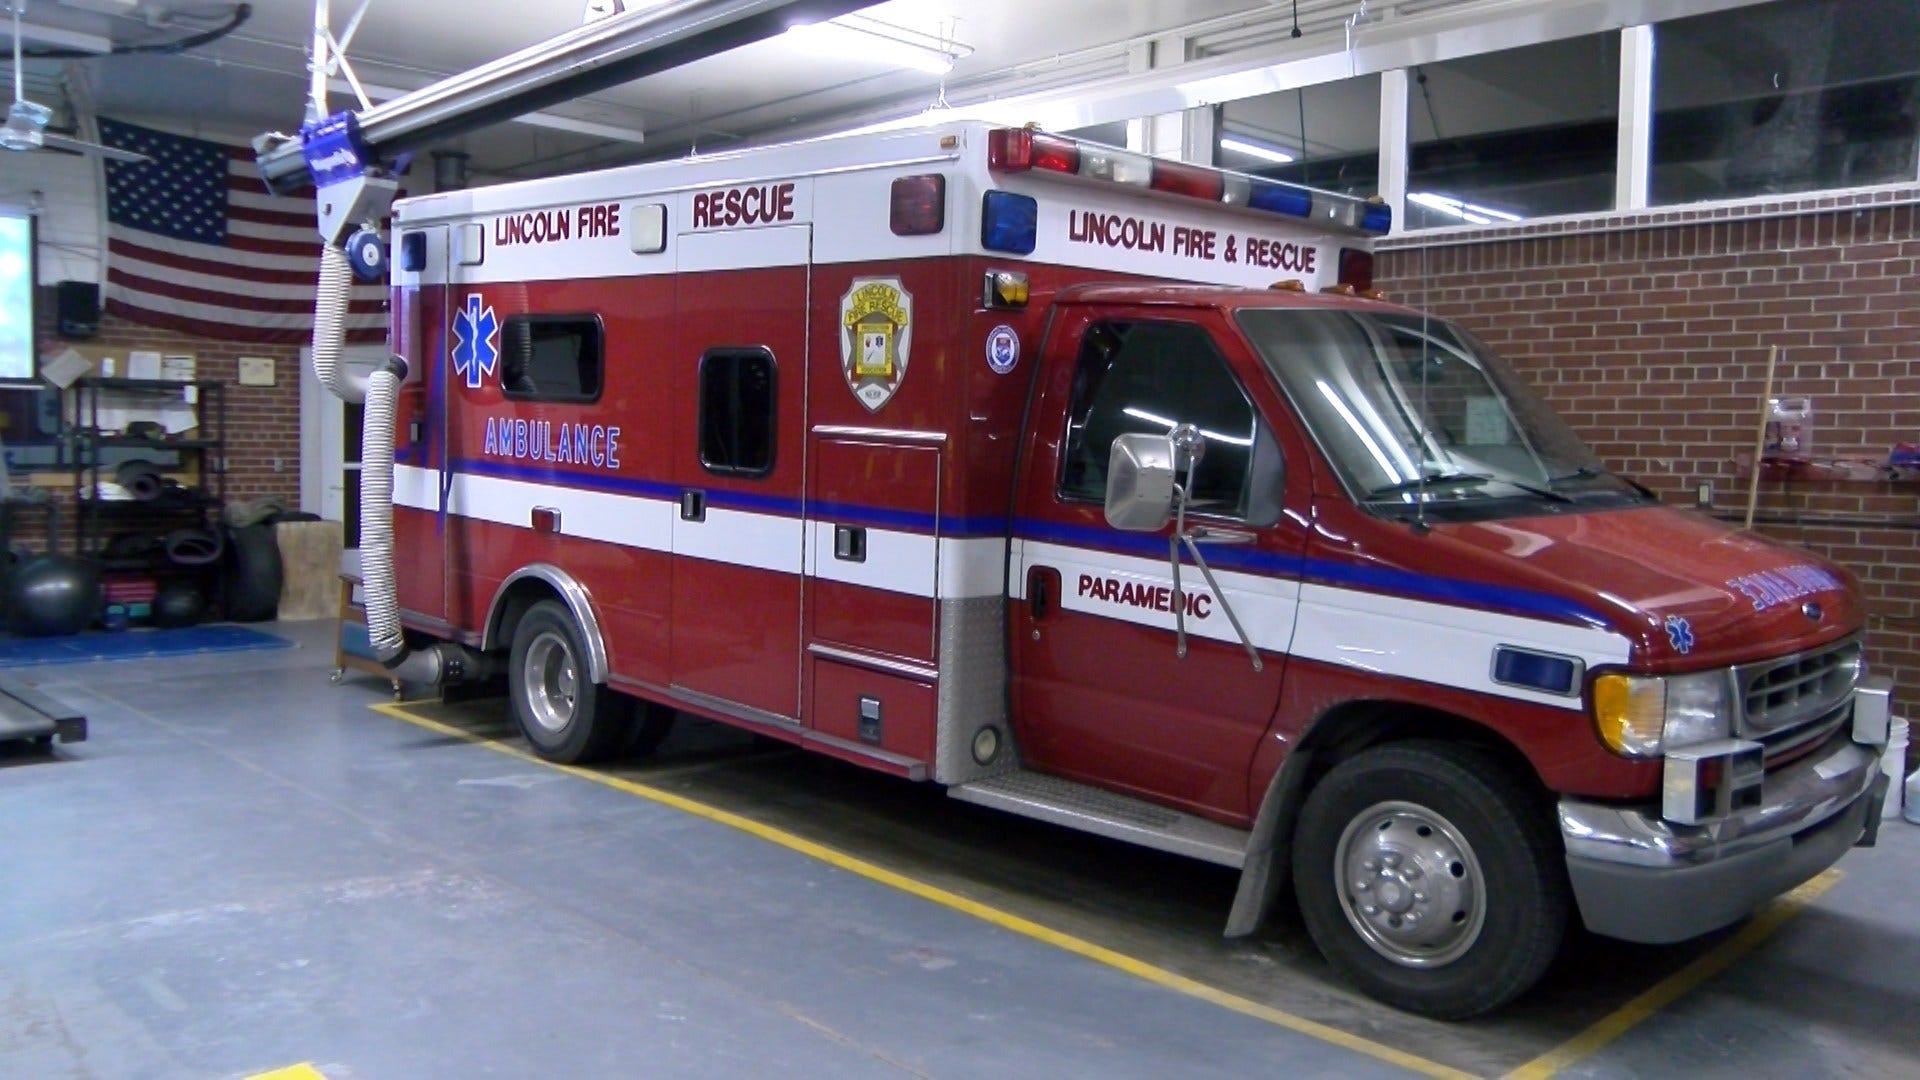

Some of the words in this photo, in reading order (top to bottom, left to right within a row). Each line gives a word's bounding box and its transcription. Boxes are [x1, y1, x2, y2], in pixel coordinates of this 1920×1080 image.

[495, 209, 570, 246] LINCOLN
[577, 203, 620, 237] FIRE
[693, 183, 795, 228] RESCUE
[1069, 210, 1166, 252] LINCOLN
[1173, 226, 1216, 260] FIRE
[1224, 234, 1238, 263] &
[1245, 237, 1317, 274] RESCUE
[484, 417, 621, 469] AMBULANCE
[1078, 573, 1212, 619] PARAMEDIC
